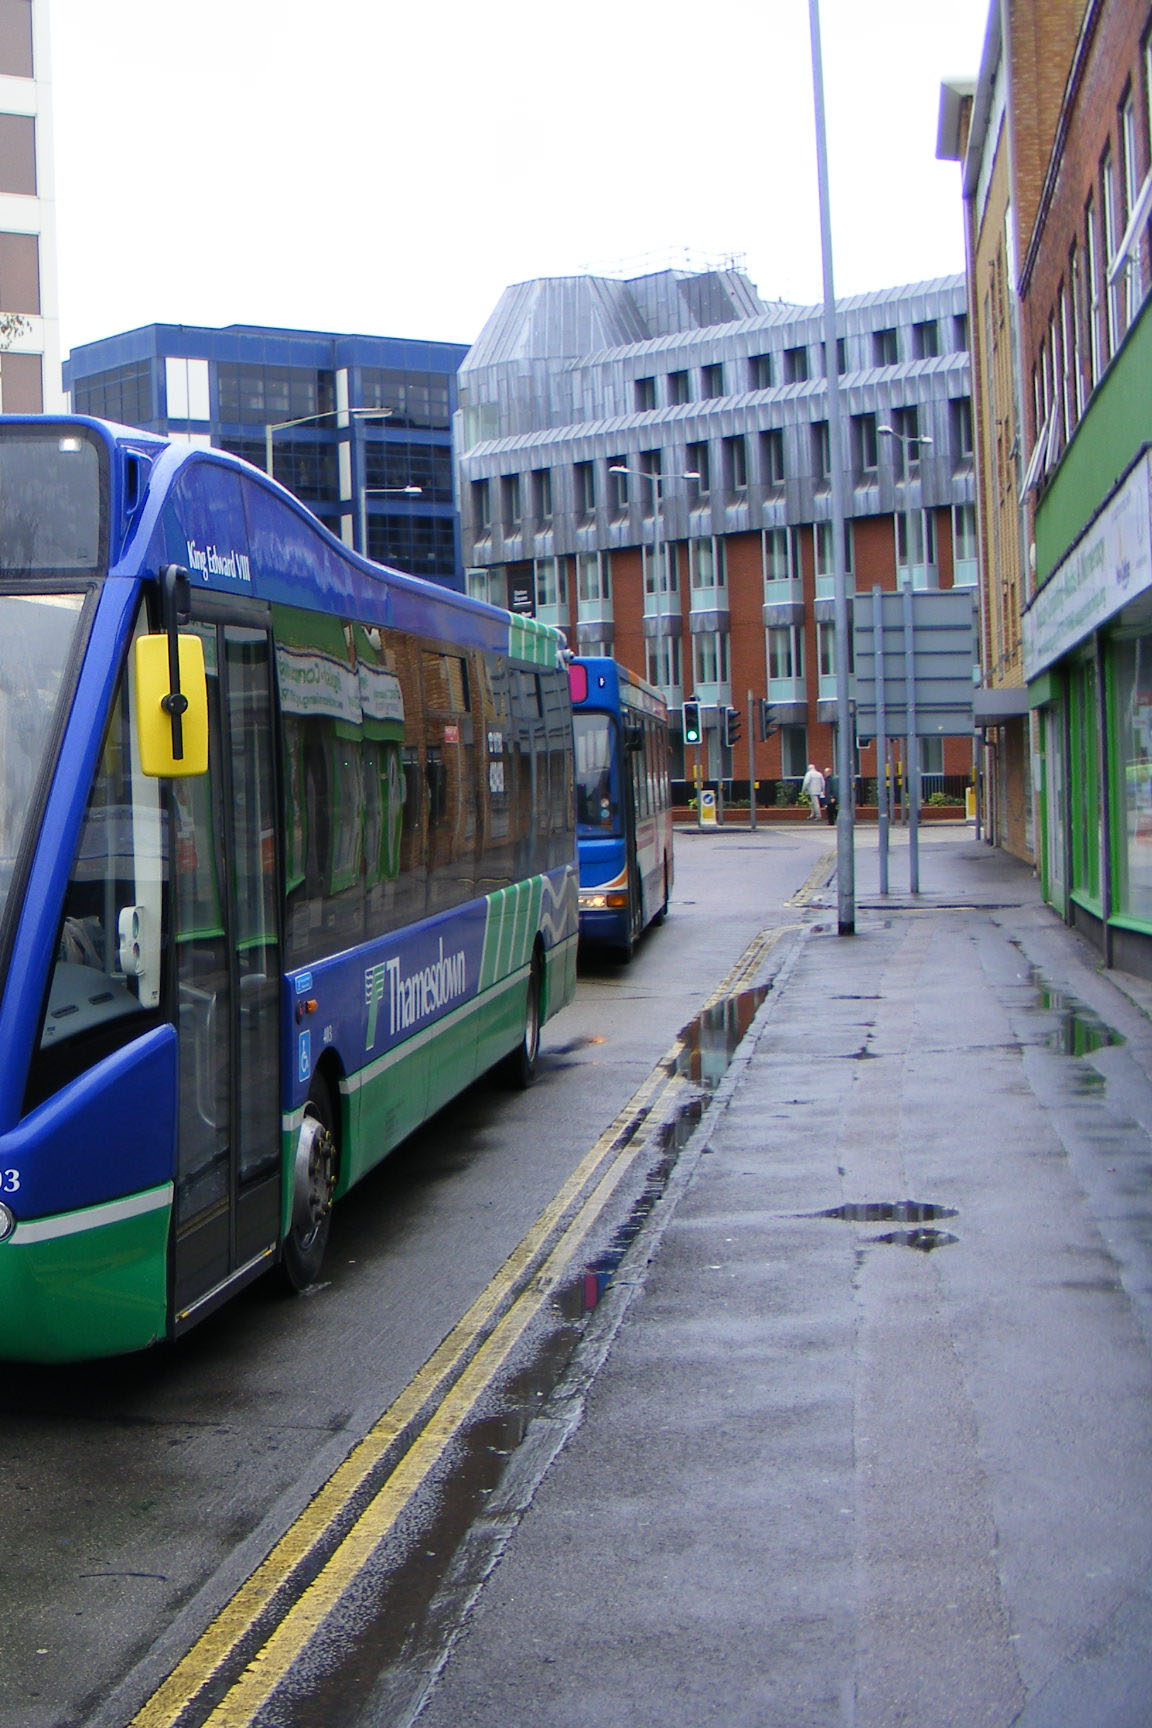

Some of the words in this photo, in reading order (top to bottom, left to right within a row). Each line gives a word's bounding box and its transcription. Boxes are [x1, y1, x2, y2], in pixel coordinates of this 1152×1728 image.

[187, 540, 209, 581] King
[206, 545, 237, 579] Edward
[385, 936, 466, 1036] Thamesdown
